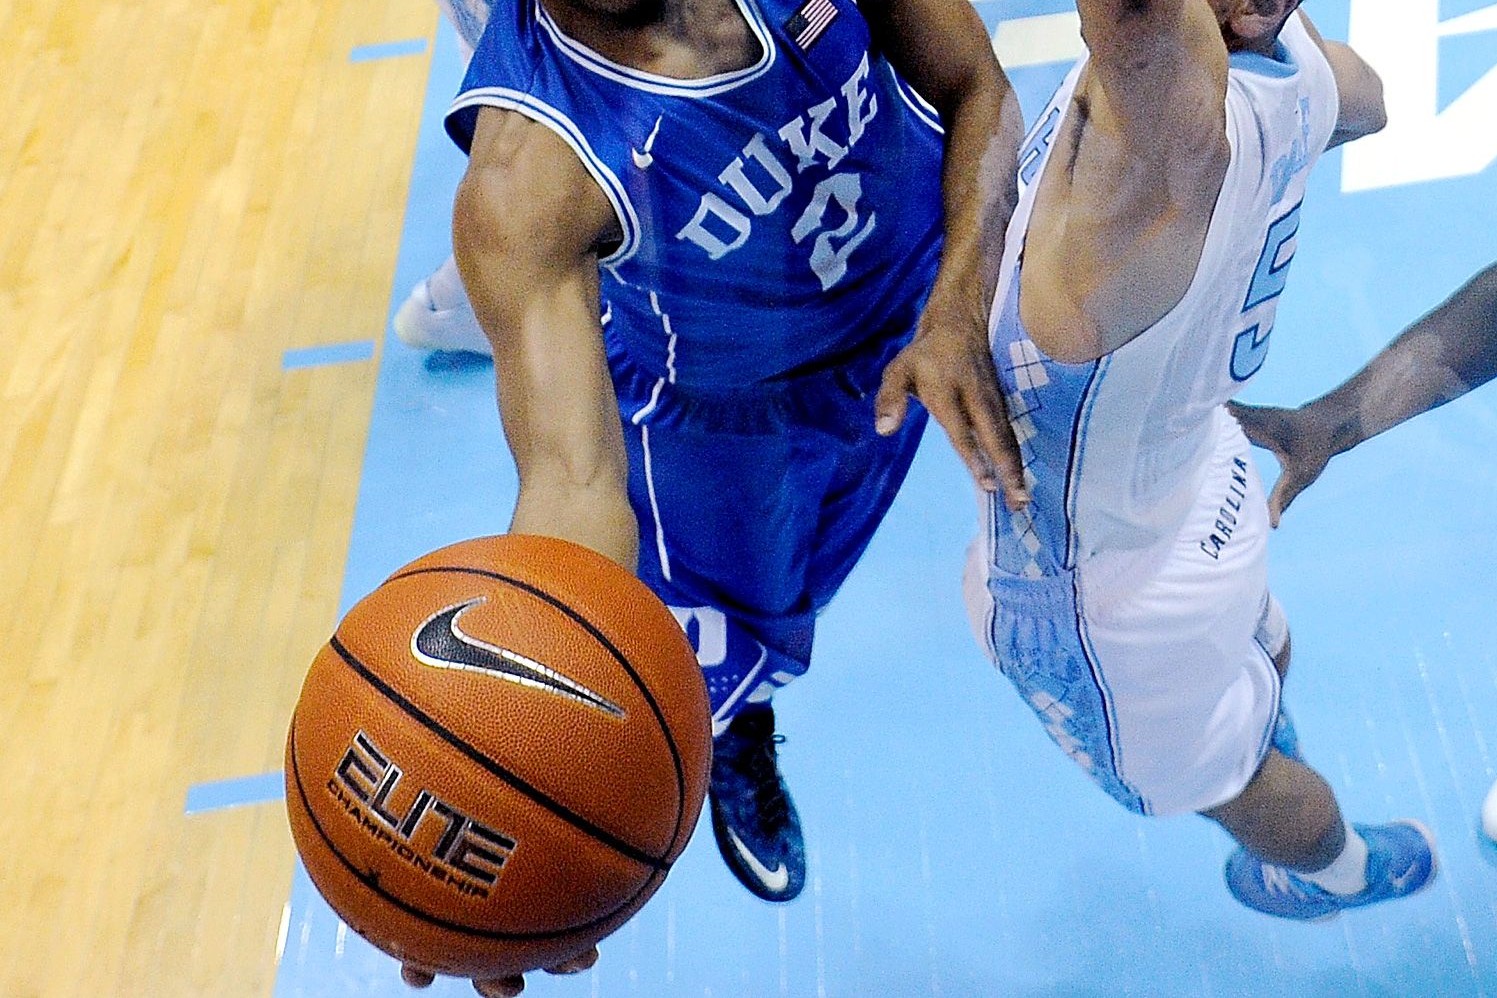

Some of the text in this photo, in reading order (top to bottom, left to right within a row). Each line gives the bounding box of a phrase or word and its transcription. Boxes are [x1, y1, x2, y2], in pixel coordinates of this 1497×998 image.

[675, 50, 878, 261] DUKE
[791, 172, 877, 292] 2
[1200, 456, 1247, 560] CAROLINA
[326, 778, 491, 899] CHAMPIONSHIP
[335, 728, 518, 887] ELITE
